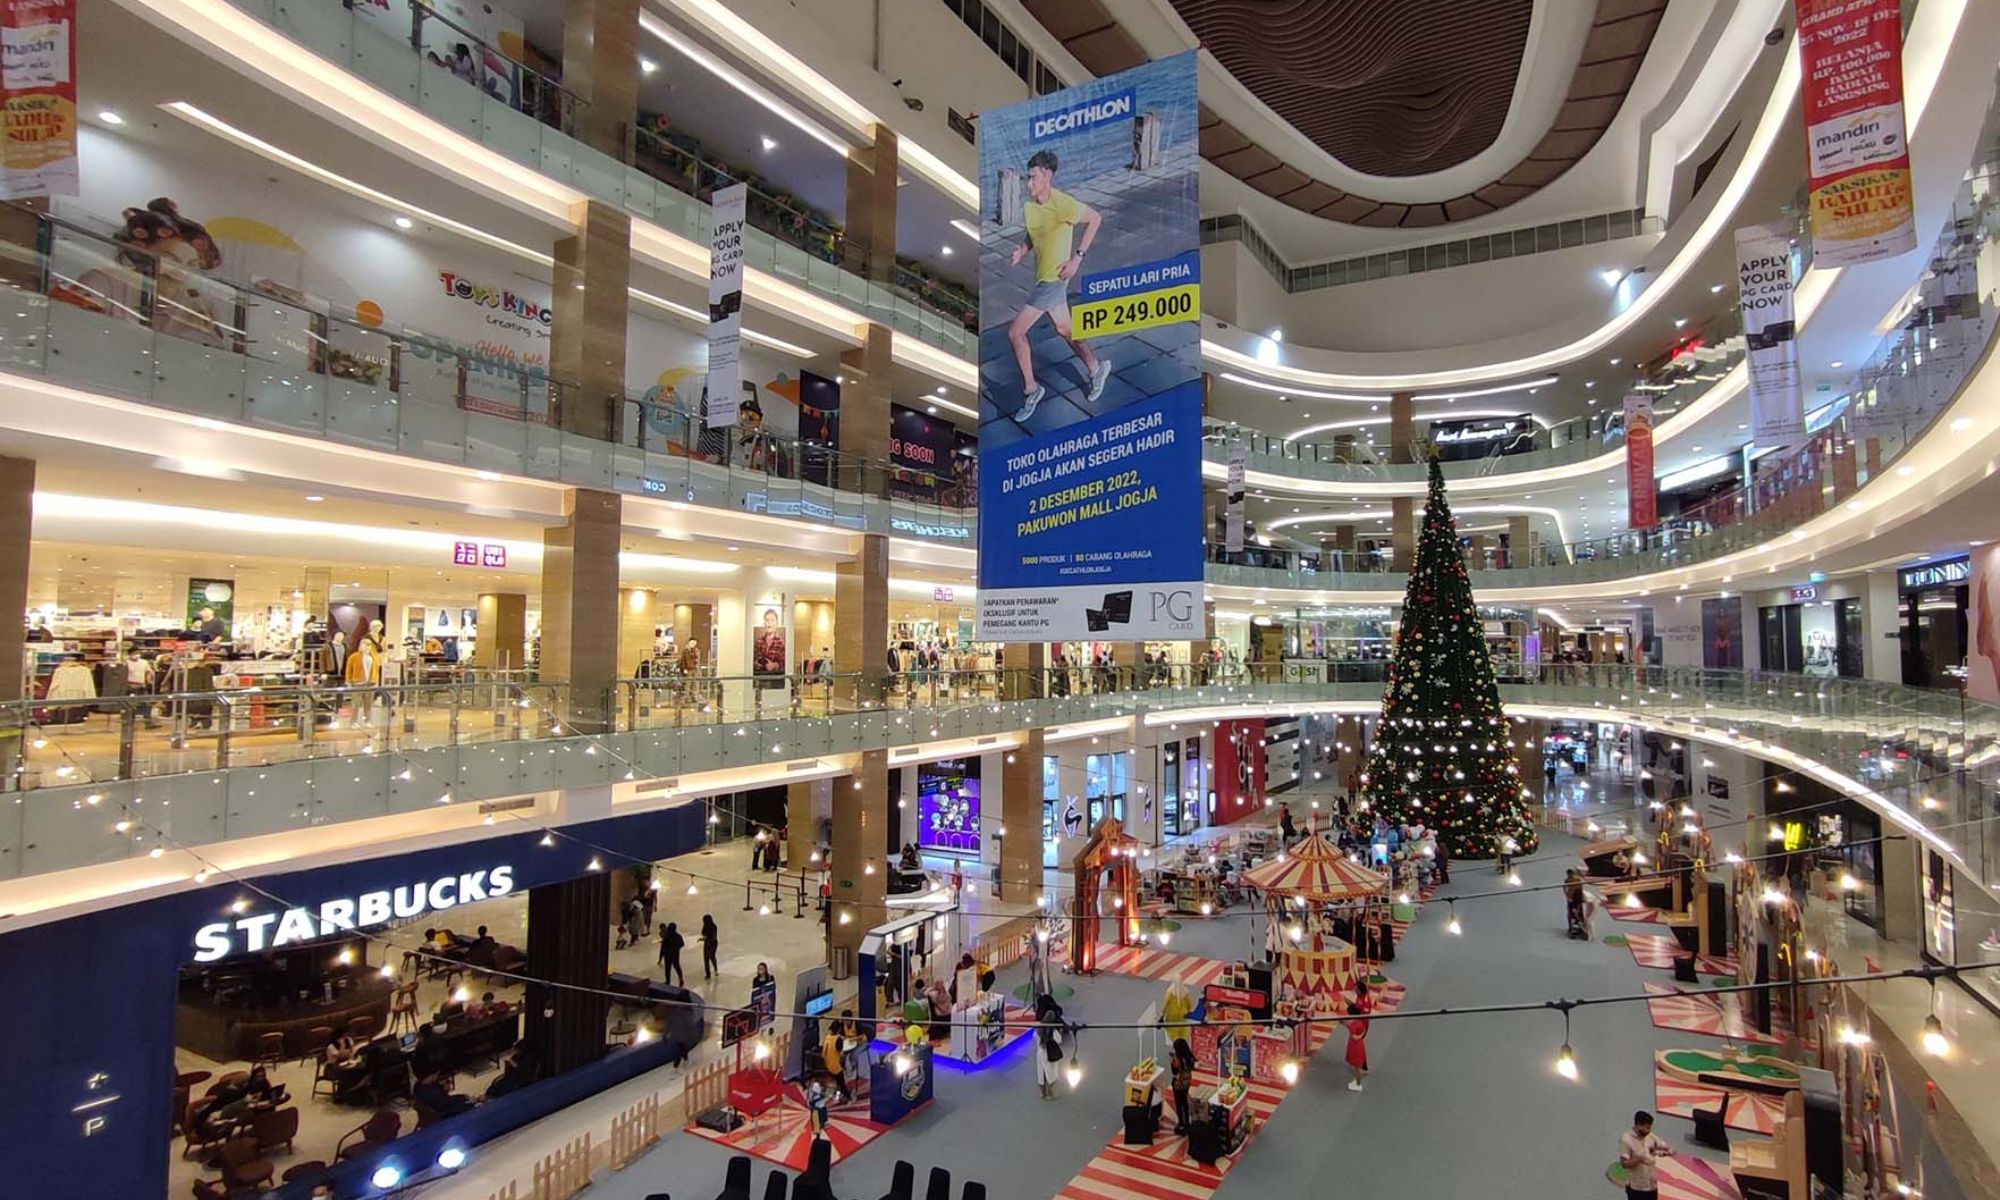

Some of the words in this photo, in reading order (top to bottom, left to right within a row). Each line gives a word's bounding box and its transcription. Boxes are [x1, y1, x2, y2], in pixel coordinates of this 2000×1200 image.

[1816, 41, 1883, 69] BELANJA
[1034, 95, 1130, 139] DECATHLON
[1740, 253, 1789, 273] APPLY
[1088, 275, 1131, 295] SEPATU
[1133, 268, 1159, 287] LARI
[1162, 263, 1190, 280] PRIA
[1740, 269, 1786, 286] YOUR
[1741, 288, 1756, 297] PG
[1760, 282, 1792, 294] CARD
[1082, 309, 1108, 331] RP
[1113, 293, 1192, 325] 249.000
[1742, 295, 1783, 311] NOW
[903, 442, 935, 465] SOON
[1007, 450, 1036, 473] TOKO
[1037, 433, 1099, 464] OLAHRAGA
[1101, 411, 1163, 444] TERBESAR
[1002, 479, 1014, 493] DI
[1015, 468, 1052, 490] JOGJA
[1054, 456, 1086, 481] AKAN
[1088, 445, 1134, 468] SEGERA
[1136, 429, 1175, 453] HADIR
[1029, 499, 1037, 514] 2
[1039, 479, 1105, 511] DESEMBER
[1106, 469, 1142, 493] 2022,
[1017, 509, 1077, 538] PAKUWON
[1079, 502, 1114, 522] MALL
[1115, 486, 1158, 511] JOGJA
[1039, 555, 1066, 564] PRODUK
[1085, 552, 1113, 562] CABANG
[1114, 550, 1152, 560] OLAHRAGA
[1017, 608, 1039, 616] UNTUK
[1148, 590, 1193, 622] PG
[983, 619, 1017, 628] PEMEGANG
[1018, 619, 1039, 627] KARTU
[1040, 619, 1050, 627] PG
[1168, 622, 1194, 631] CARD
[193, 865, 513, 963] STARBUCKS
